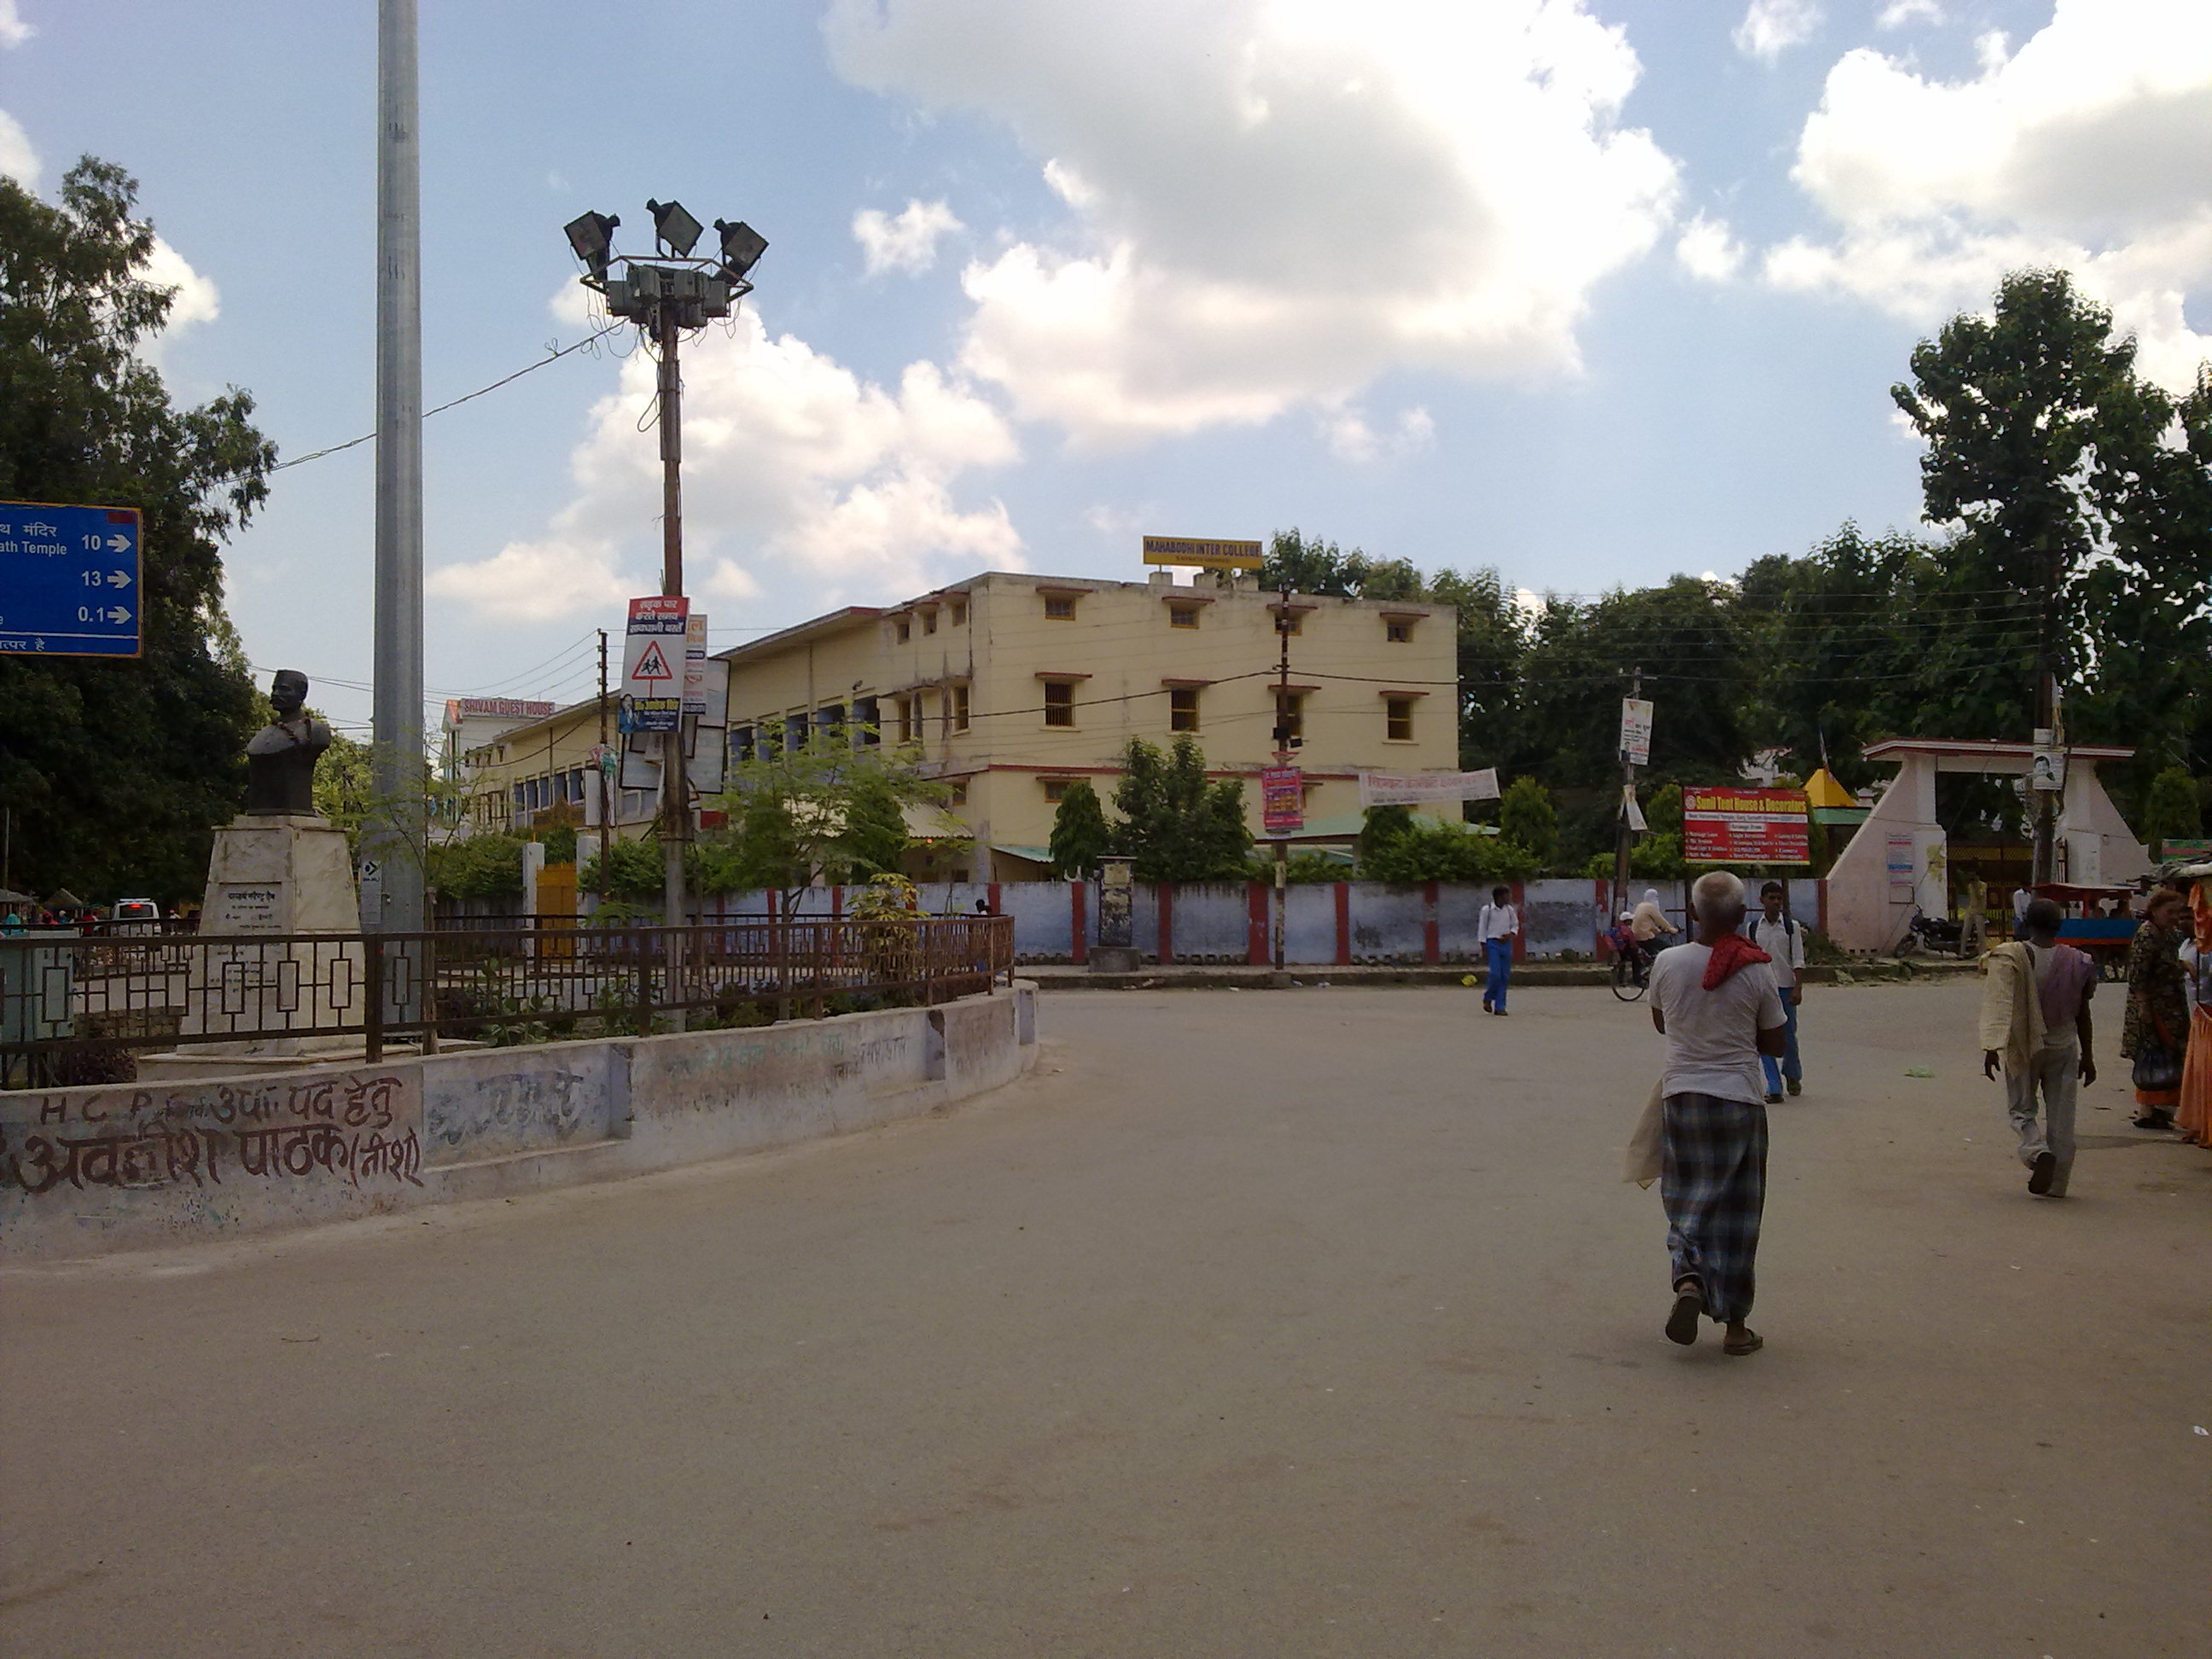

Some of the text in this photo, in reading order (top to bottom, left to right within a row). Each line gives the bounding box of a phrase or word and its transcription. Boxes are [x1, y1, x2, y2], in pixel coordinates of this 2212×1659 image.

[23, 521, 57, 538] मंदिर
[21, 540, 67, 557] Temple
[81, 534, 102, 550] 10
[1146, 540, 1260, 557] MAHABODHI INTER COLLEGE
[81, 571, 102, 586] 13
[78, 606, 104, 622] 0.1
[464, 699, 552, 715] SHIVAM GUEST HOUSE
[1716, 796, 1734, 811] Tent
[1734, 797, 1758, 812] House
[1759, 799, 1765, 812] &
[288, 1080, 338, 1121] पद
[344, 1075, 403, 1129] हेतु
[232, 1124, 348, 1178] पाठक
